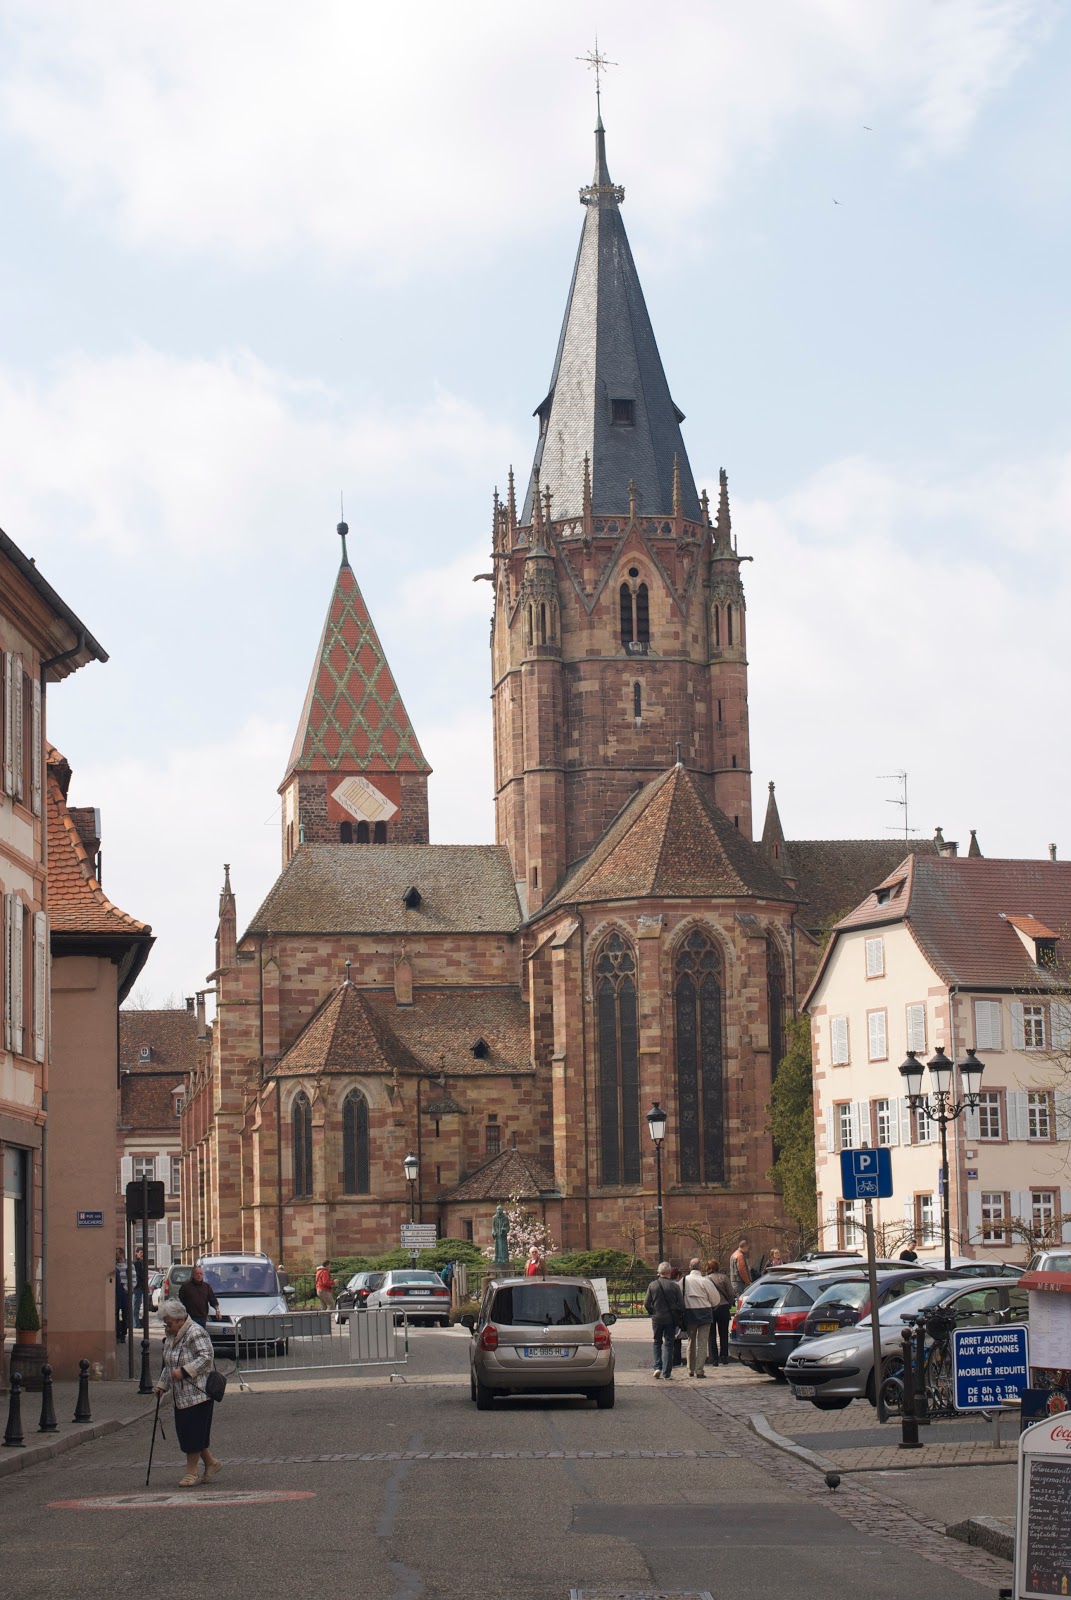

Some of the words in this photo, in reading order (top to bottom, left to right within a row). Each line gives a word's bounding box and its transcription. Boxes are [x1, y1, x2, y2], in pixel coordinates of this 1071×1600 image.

[859, 1154, 871, 1171] P
[1037, 1282, 1061, 1291] MENU
[959, 1336, 981, 1345] ARRET
[983, 1334, 1018, 1344] AUTORISE
[959, 1347, 974, 1355] AUX
[977, 1344, 1019, 1355] PERSONNES
[986, 1356, 992, 1364] A
[958, 1367, 992, 1377] MOBILITE
[994, 1366, 1025, 1375] REDUITE
[967, 1387, 978, 1395] DE
[981, 1386, 992, 1394] 8h
[995, 1385, 1001, 1393] à
[1004, 1385, 1018, 1393] 12h
[968, 1395, 978, 1403] DE
[981, 1394, 994, 1402] 14h
